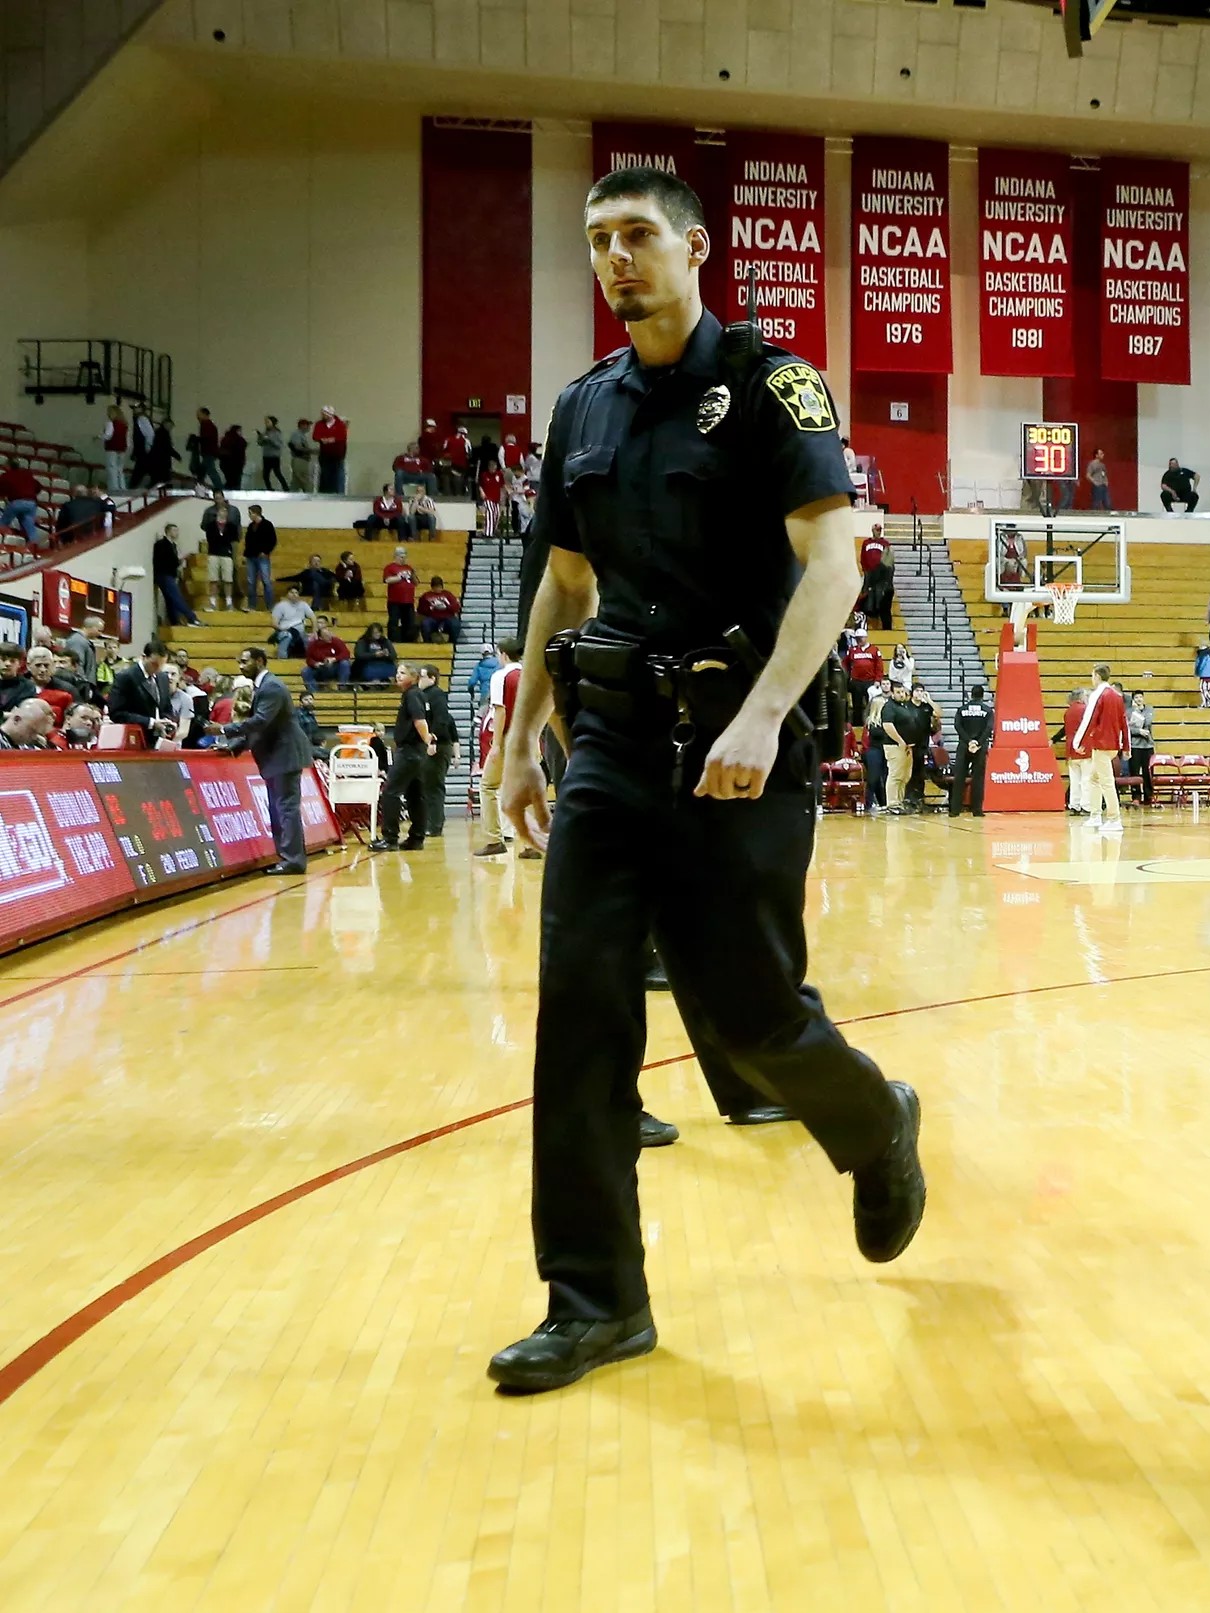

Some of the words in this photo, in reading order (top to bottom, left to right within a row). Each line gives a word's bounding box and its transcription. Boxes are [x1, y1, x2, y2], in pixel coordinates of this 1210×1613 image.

[610, 151, 677, 175] INDIANA
[744, 161, 808, 184] INDIANA
[872, 169, 935, 191] INDIANA
[995, 176, 1056, 199] INDIANA
[734, 185, 818, 210] UNIVERSITY
[861, 193, 944, 217] UNIVERSITY
[1116, 185, 1175, 207] INDIANA
[985, 200, 1065, 224] UNIVERSITY
[1106, 208, 1183, 232] UNIVERSITY
[731, 216, 821, 254] NCAA
[858, 223, 947, 259] NCAA
[983, 229, 1068, 264] NCAA
[1103, 237, 1186, 272] NCAA
[860, 265, 944, 289] BASKETBALL
[985, 271, 1067, 294] BASKETBALL
[863, 290, 941, 314] CHAMPIONS
[1105, 278, 1185, 302] BASKETBALL
[988, 296, 1064, 318] CHAMPIONS
[1109, 303, 1182, 327] CHAMPIONS
[886, 322, 923, 344] 1976
[1012, 327, 1043, 349] 1981
[1128, 334, 1164, 356] 1987
[771, 366, 820, 390] POLICE
[513, 401, 519, 412] 5
[896, 409, 903, 419] 6
[1028, 427, 1071, 445] 30:00
[1034, 445, 1066, 473] 30
[1001, 717, 1041, 735] meijer
